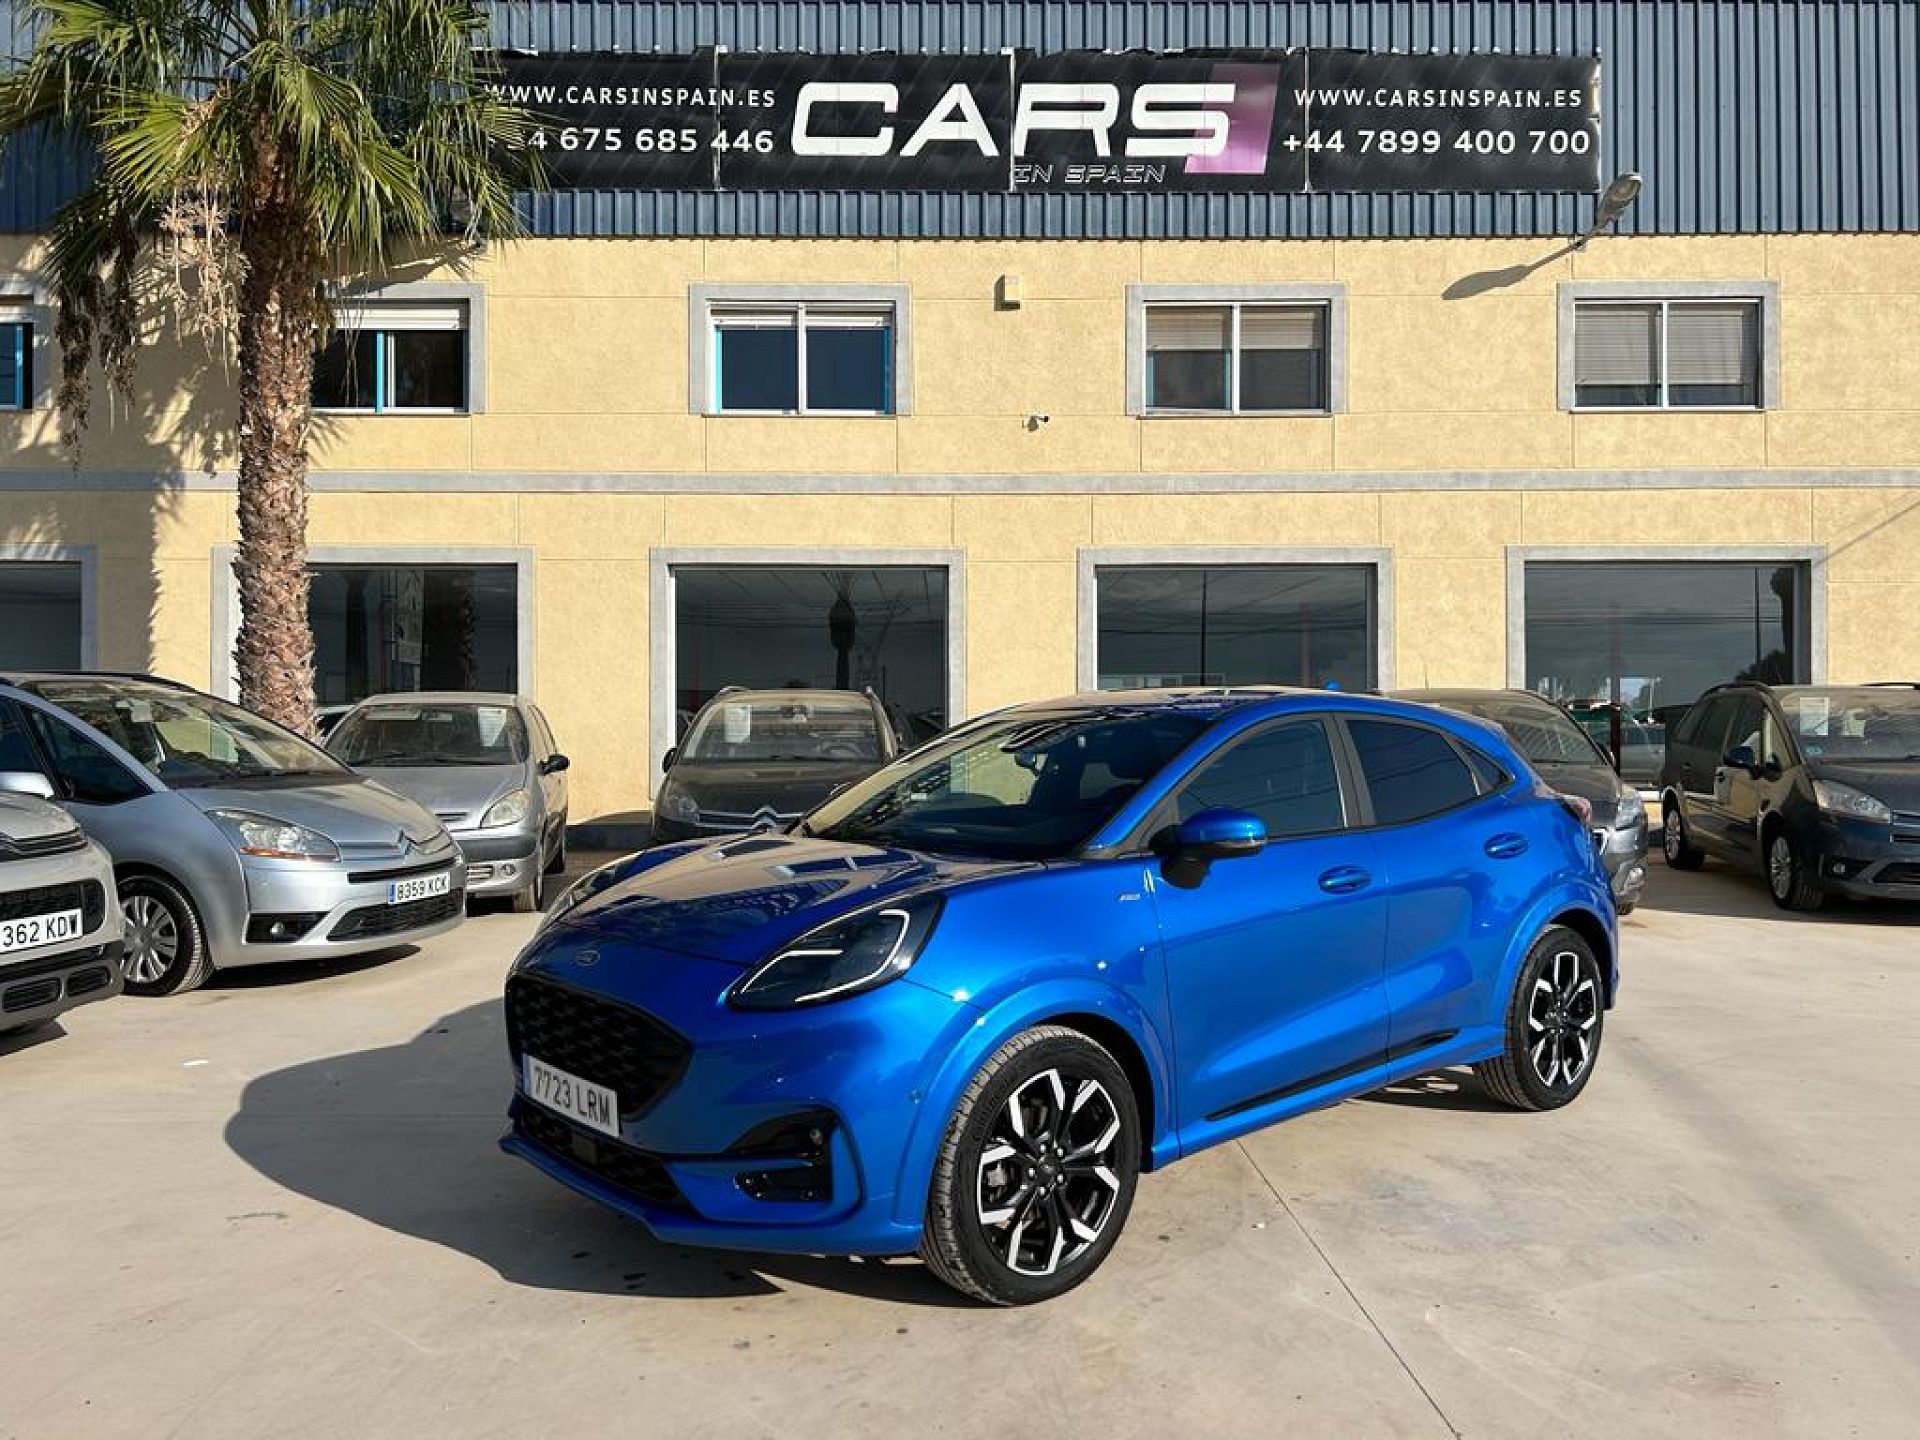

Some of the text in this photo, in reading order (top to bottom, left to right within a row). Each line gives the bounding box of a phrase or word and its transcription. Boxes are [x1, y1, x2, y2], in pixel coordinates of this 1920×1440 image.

[1293, 88, 1582, 108] WWW.CARSINSPAIN.ES
[790, 81, 1236, 157] CARS
[559, 126, 622, 152] 675
[635, 128, 698, 153] 685
[710, 129, 774, 153] 446
[1283, 130, 1590, 154] +44 7899 400 700
[1013, 164, 1167, 183] IN SPAIN
[534, 1065, 611, 1127] 7723 LRM
